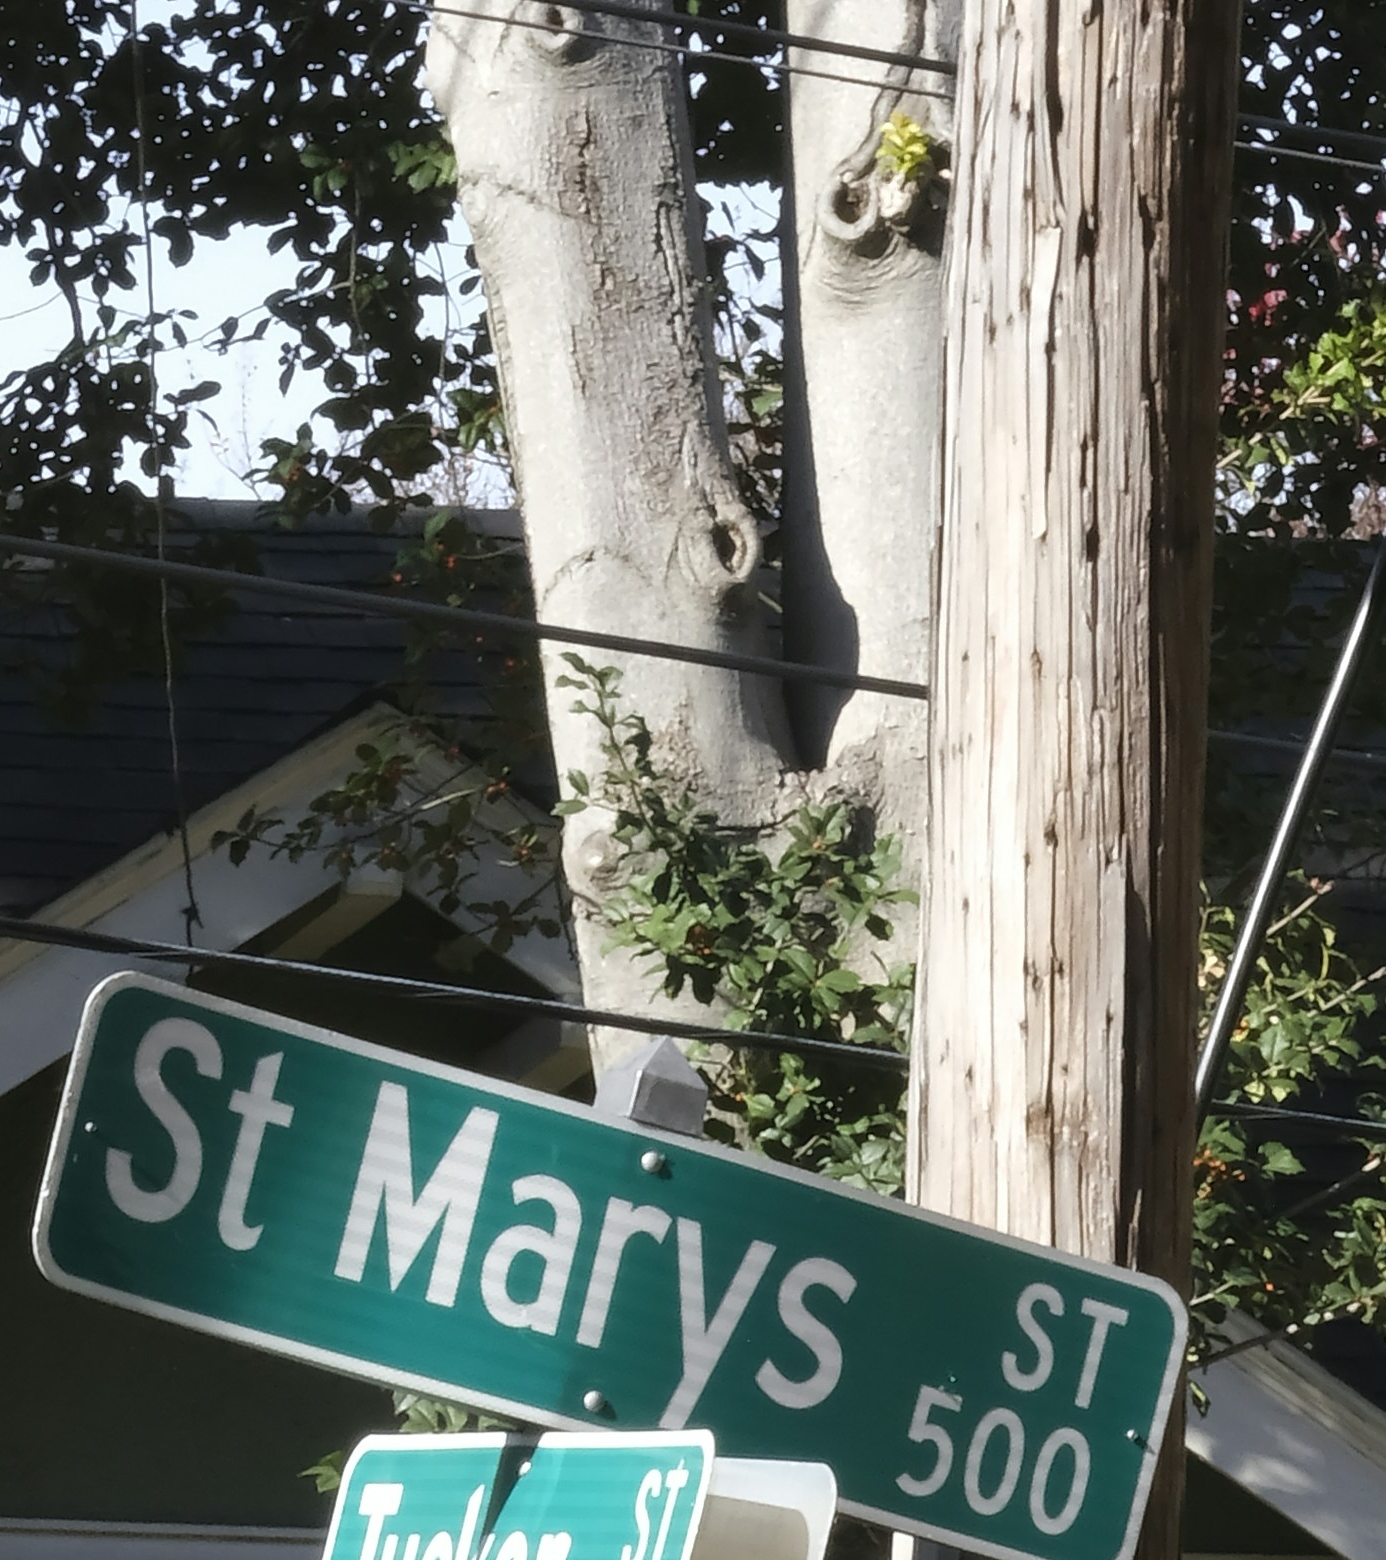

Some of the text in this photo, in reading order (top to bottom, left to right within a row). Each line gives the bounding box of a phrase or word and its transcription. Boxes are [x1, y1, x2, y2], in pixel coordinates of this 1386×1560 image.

[108, 1017, 858, 1428] St Marys
[1003, 1284, 1128, 1409] ST
[897, 1386, 1090, 1534] 500
